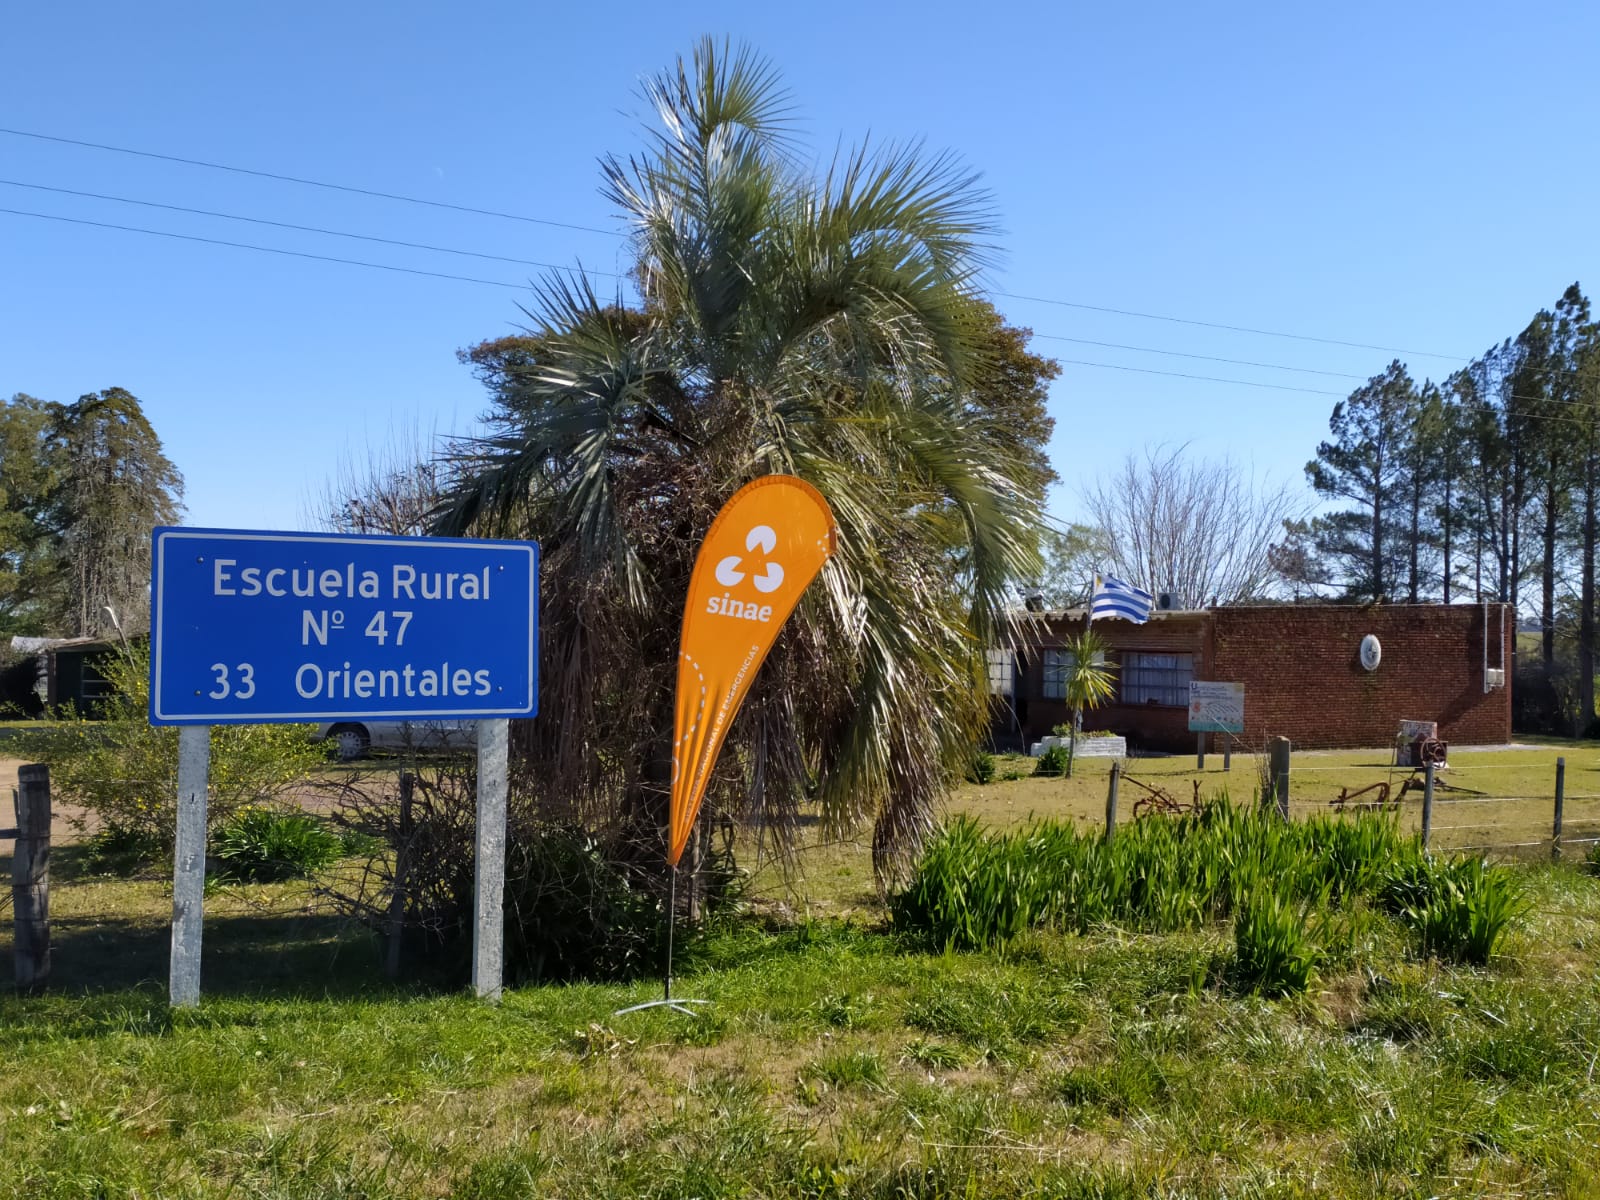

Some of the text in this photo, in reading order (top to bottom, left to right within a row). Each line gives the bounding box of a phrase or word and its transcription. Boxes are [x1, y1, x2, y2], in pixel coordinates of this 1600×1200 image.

[214, 559, 490, 600] Escuela Rural
[706, 592, 772, 622] sinae
[365, 610, 413, 646] 47
[209, 662, 491, 700] 33 Orientales
[717, 710, 726, 726] DE
[722, 645, 760, 711] EMERGENCIAS
